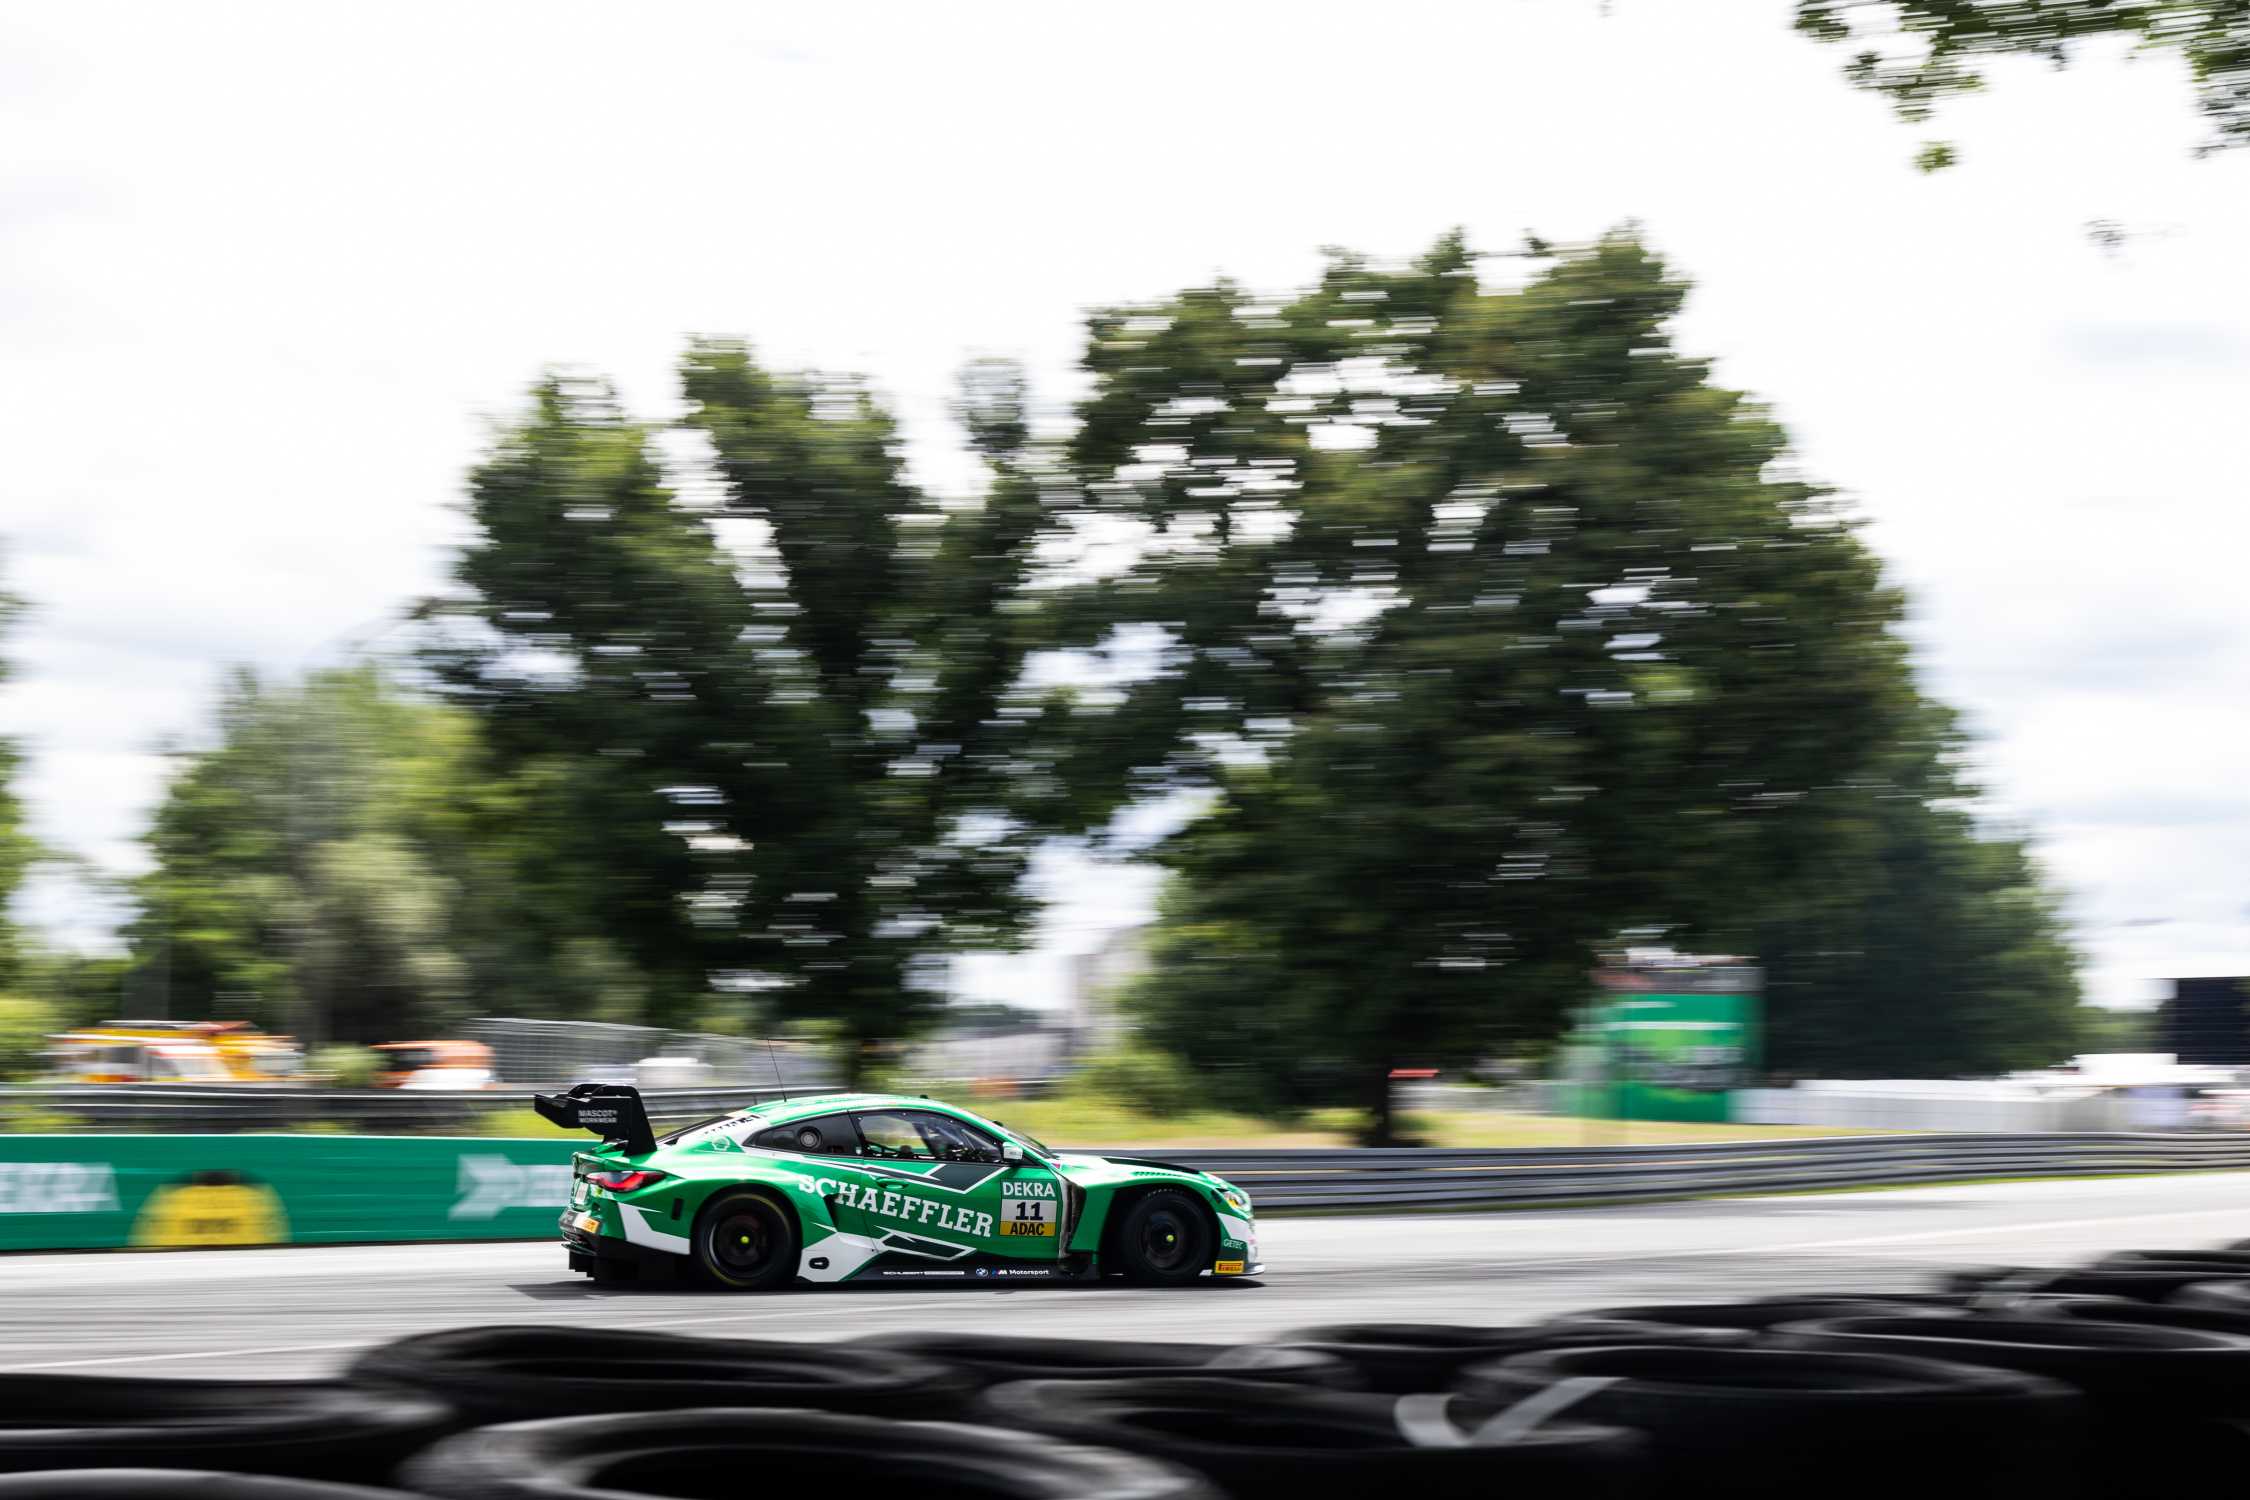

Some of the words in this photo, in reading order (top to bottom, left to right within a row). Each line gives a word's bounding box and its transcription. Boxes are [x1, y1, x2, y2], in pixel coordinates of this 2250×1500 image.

[1002, 1181, 1056, 1198] DEKRA
[798, 1173, 994, 1238] SCHAEFFLER
[1015, 1201, 1043, 1221] 11
[1009, 1222, 1045, 1236] ADAC
[1008, 1269, 1049, 1277] Motorsport
